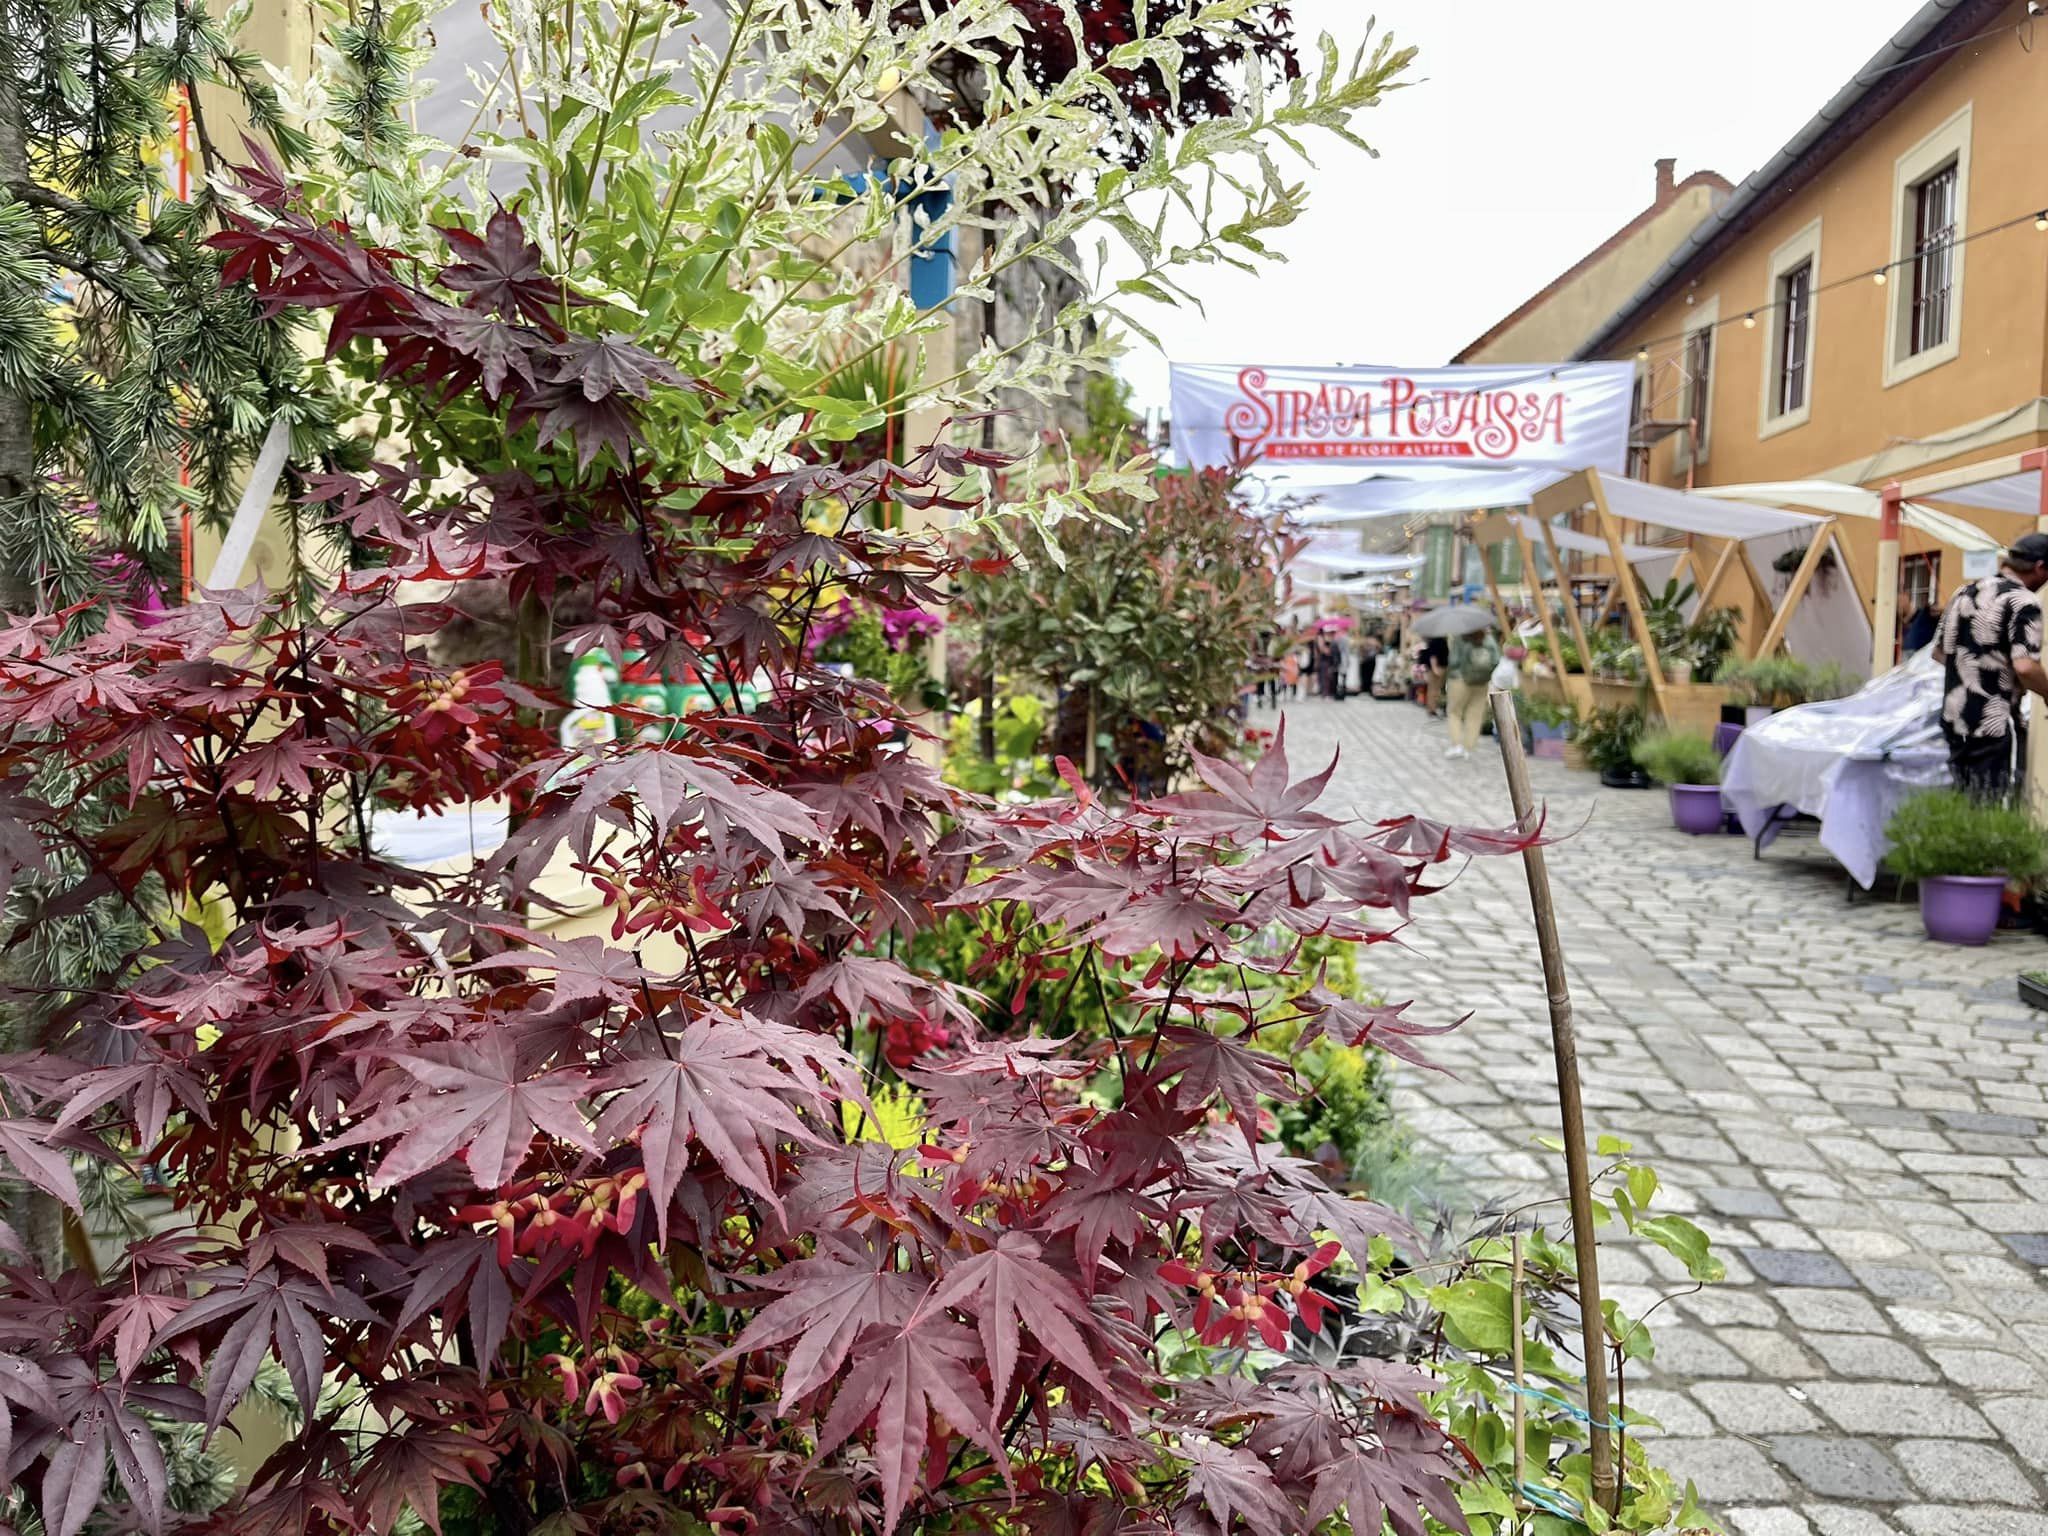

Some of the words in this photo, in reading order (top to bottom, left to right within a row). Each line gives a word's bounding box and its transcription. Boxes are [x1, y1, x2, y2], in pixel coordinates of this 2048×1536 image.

[1225, 367, 1372, 442] STRADA
[1381, 377, 1566, 459] POTAISSA
[1324, 444, 1345, 456] DE
